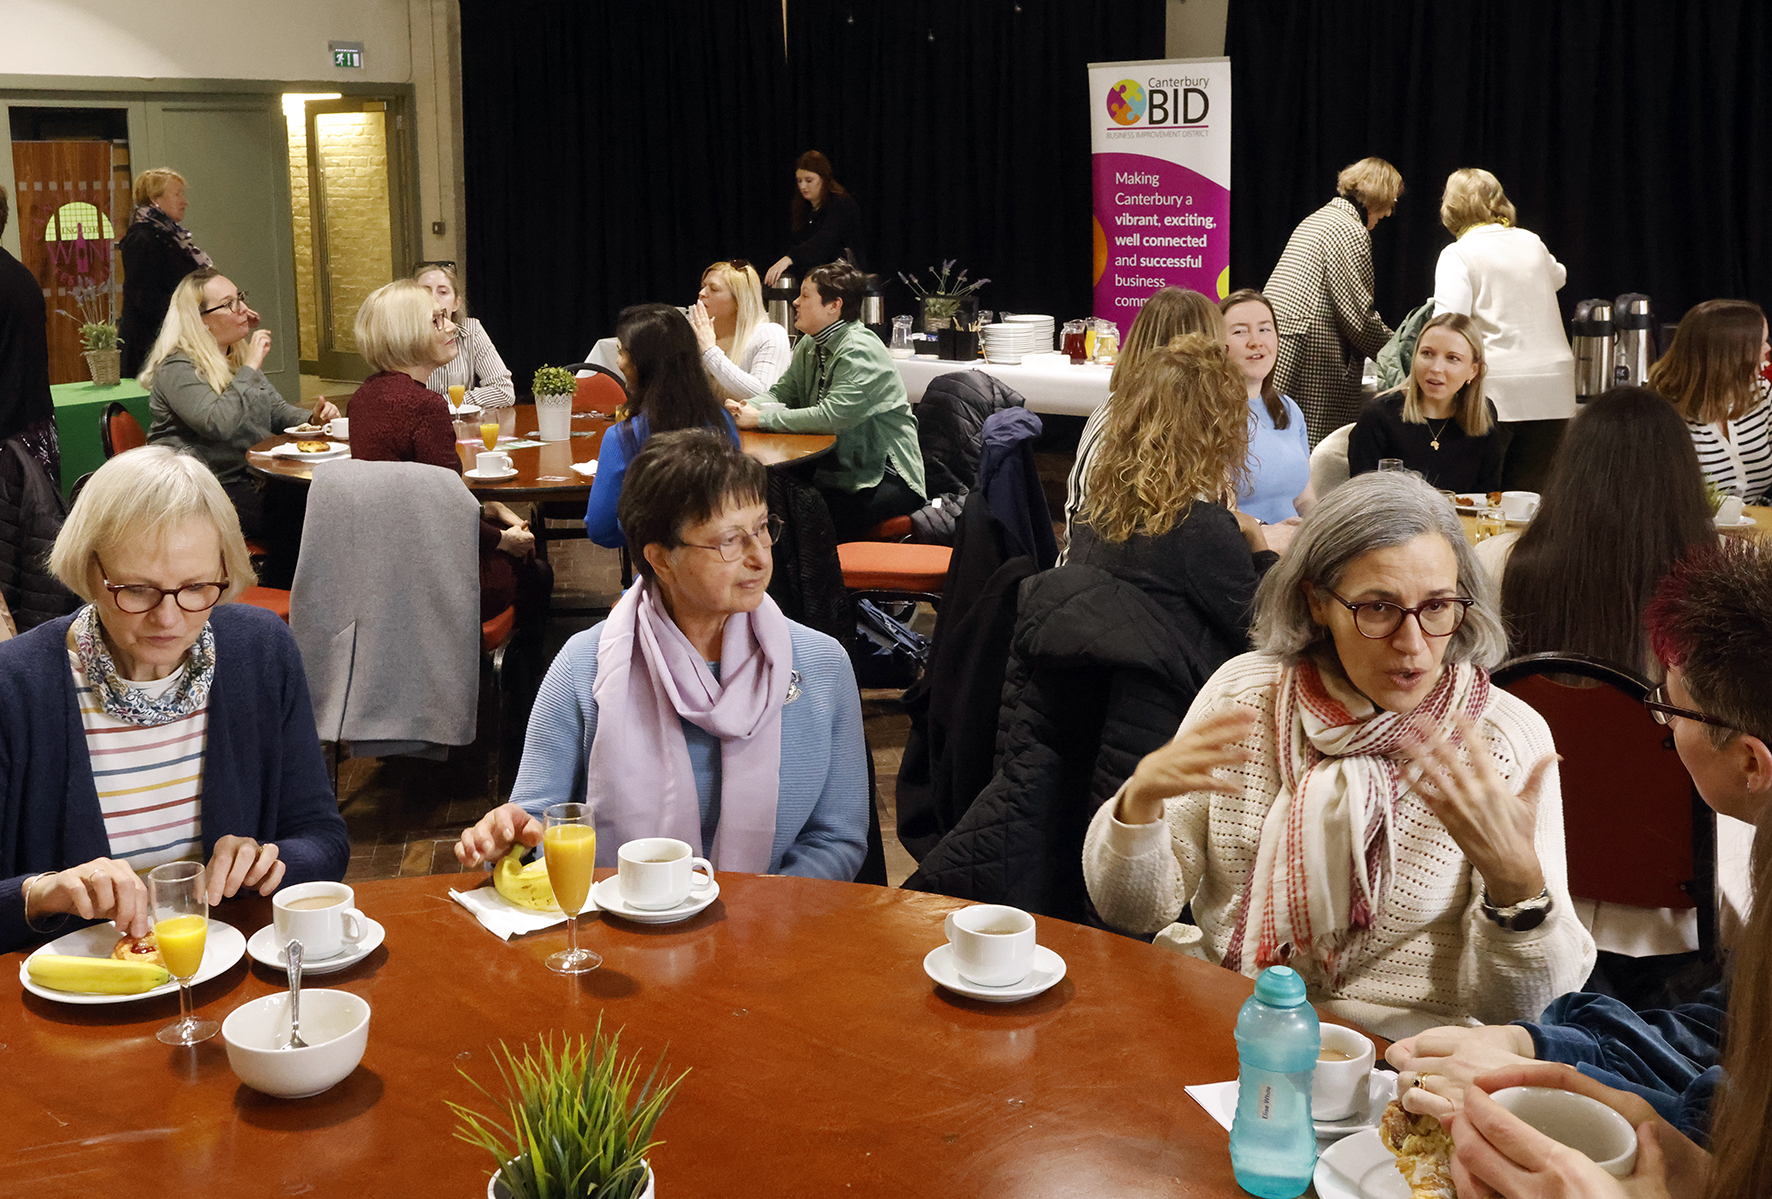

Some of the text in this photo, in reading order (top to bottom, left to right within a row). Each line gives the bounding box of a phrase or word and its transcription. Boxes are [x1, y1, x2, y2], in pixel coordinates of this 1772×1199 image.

[1148, 76, 1210, 89] Canterbury
[1148, 88, 1210, 125] BID
[1106, 129, 1209, 139] BUSINESS IMPROVEMENT DISTRICT
[1115, 171, 1160, 188] Making
[1115, 192, 1193, 208] Canterbury a
[1115, 212, 1217, 229] vibrant, exciting,
[61, 226, 99, 234] ENGISH
[1115, 233, 1207, 247] well connected
[1114, 254, 1202, 268] and successful
[1115, 273, 1166, 288] business
